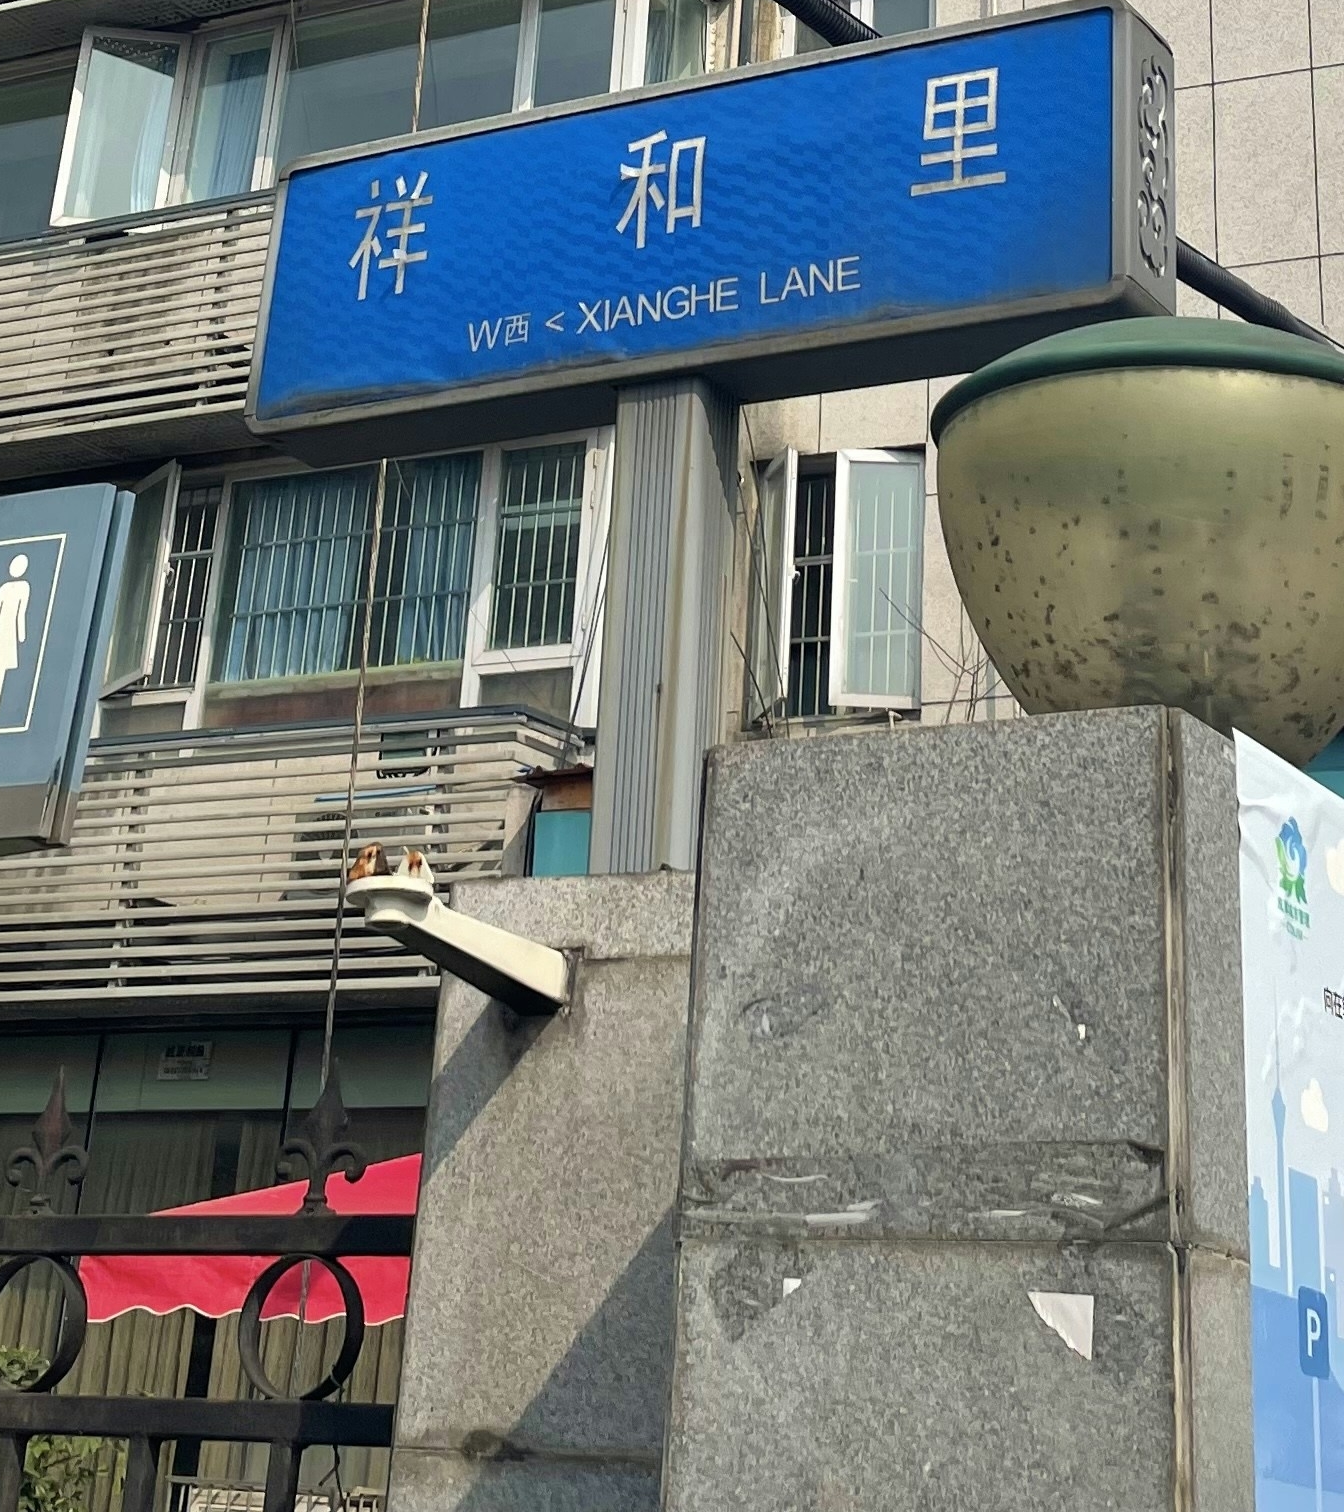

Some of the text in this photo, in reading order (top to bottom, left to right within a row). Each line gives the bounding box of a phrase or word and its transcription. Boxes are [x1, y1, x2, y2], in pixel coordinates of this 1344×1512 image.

[348, 67, 1007, 301] 祥和里
[576, 276, 740, 335] XIANGHE
[759, 255, 861, 305] LANE
[1307, 1307, 1321, 1358] P
